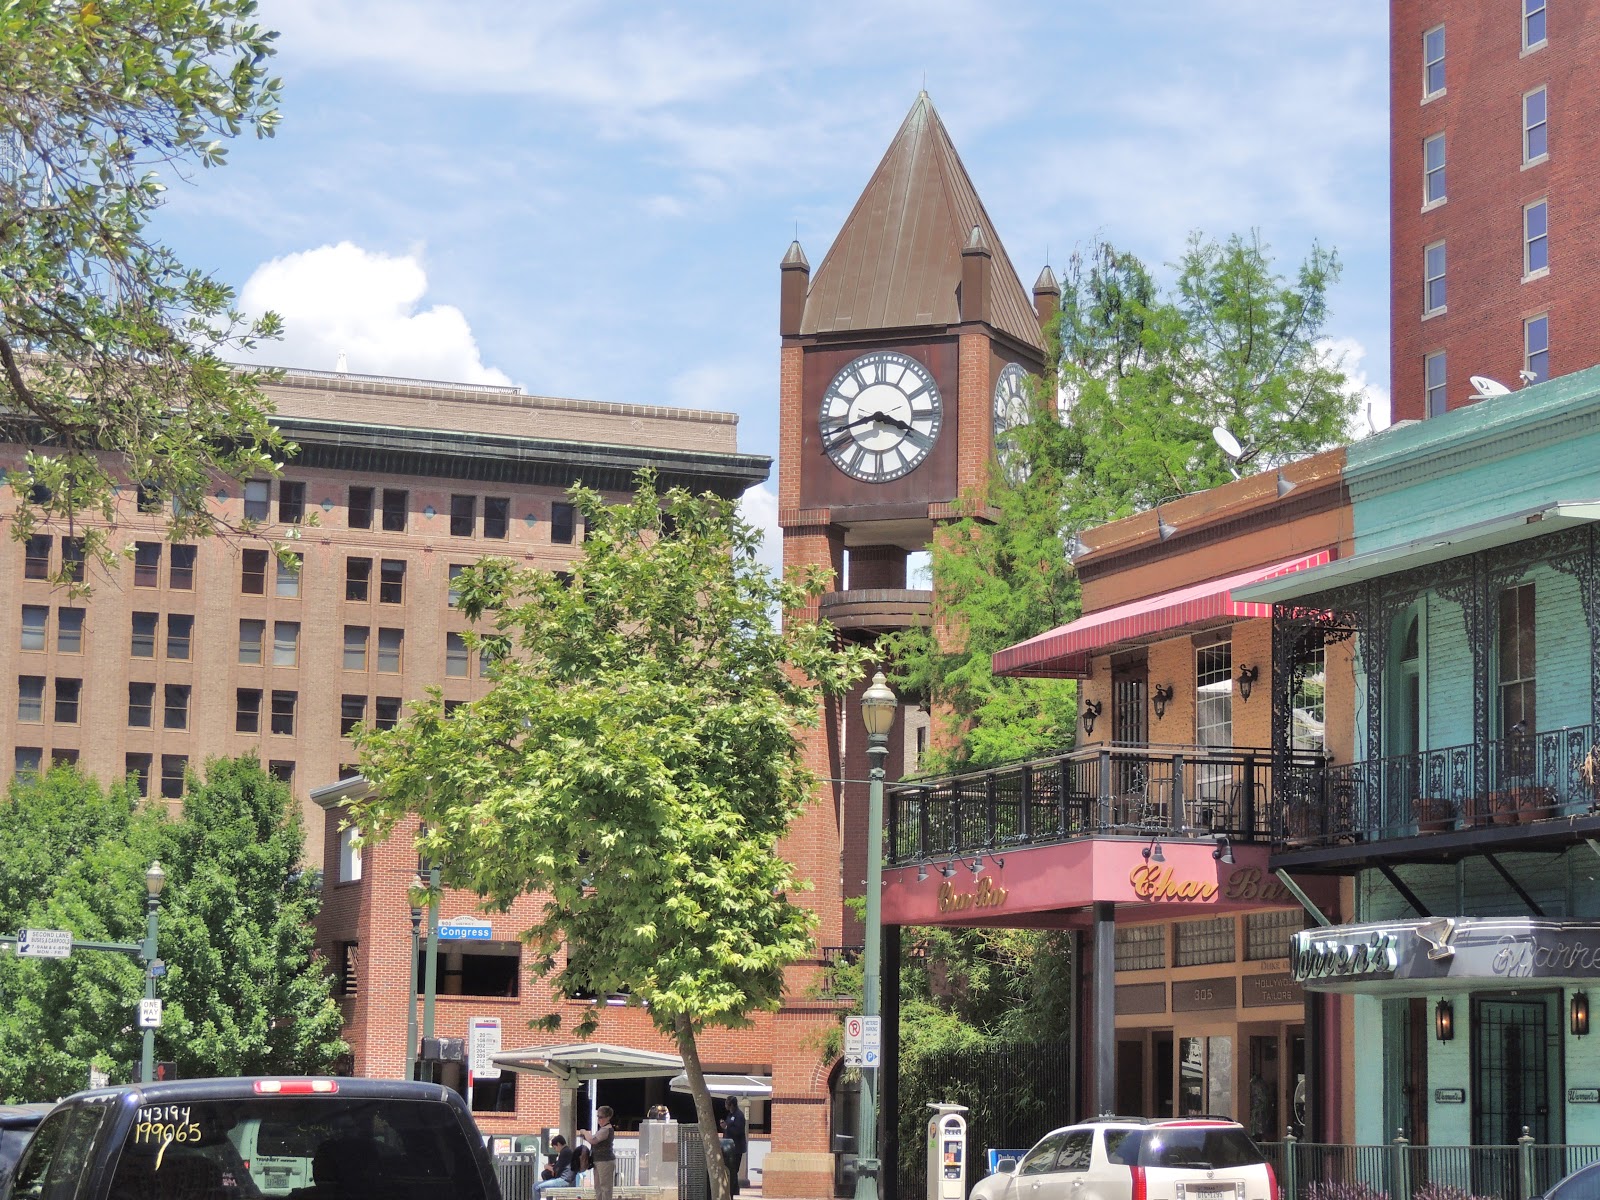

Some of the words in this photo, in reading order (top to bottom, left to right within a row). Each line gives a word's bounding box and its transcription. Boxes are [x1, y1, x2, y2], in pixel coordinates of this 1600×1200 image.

[1129, 863, 1220, 902] Char
[1223, 865, 1296, 900] Bar
[975, 876, 1009, 908] Bar
[440, 926, 489, 938] Congress
[1194, 988, 1213, 1001] 305
[1262, 991, 1292, 1001] TAILORS
[138, 1105, 191, 1126] 143194
